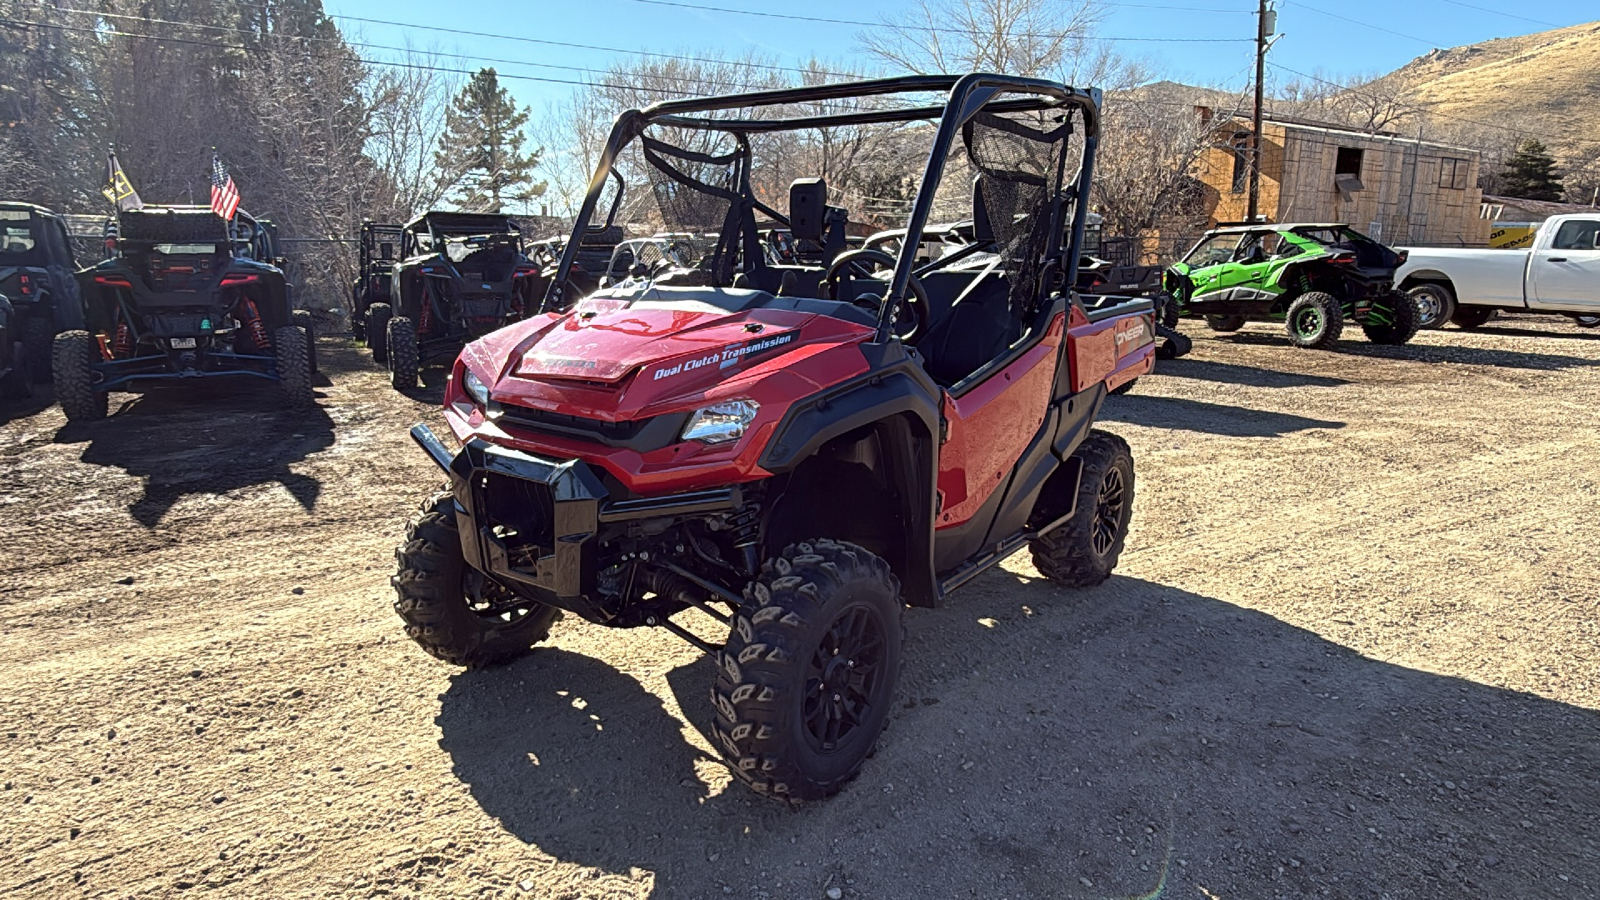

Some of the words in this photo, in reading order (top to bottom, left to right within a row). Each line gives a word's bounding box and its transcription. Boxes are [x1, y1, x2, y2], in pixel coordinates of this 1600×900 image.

[653, 363, 682, 380] Dual
[683, 354, 720, 371] Clutch
[722, 335, 791, 360] Transmission
